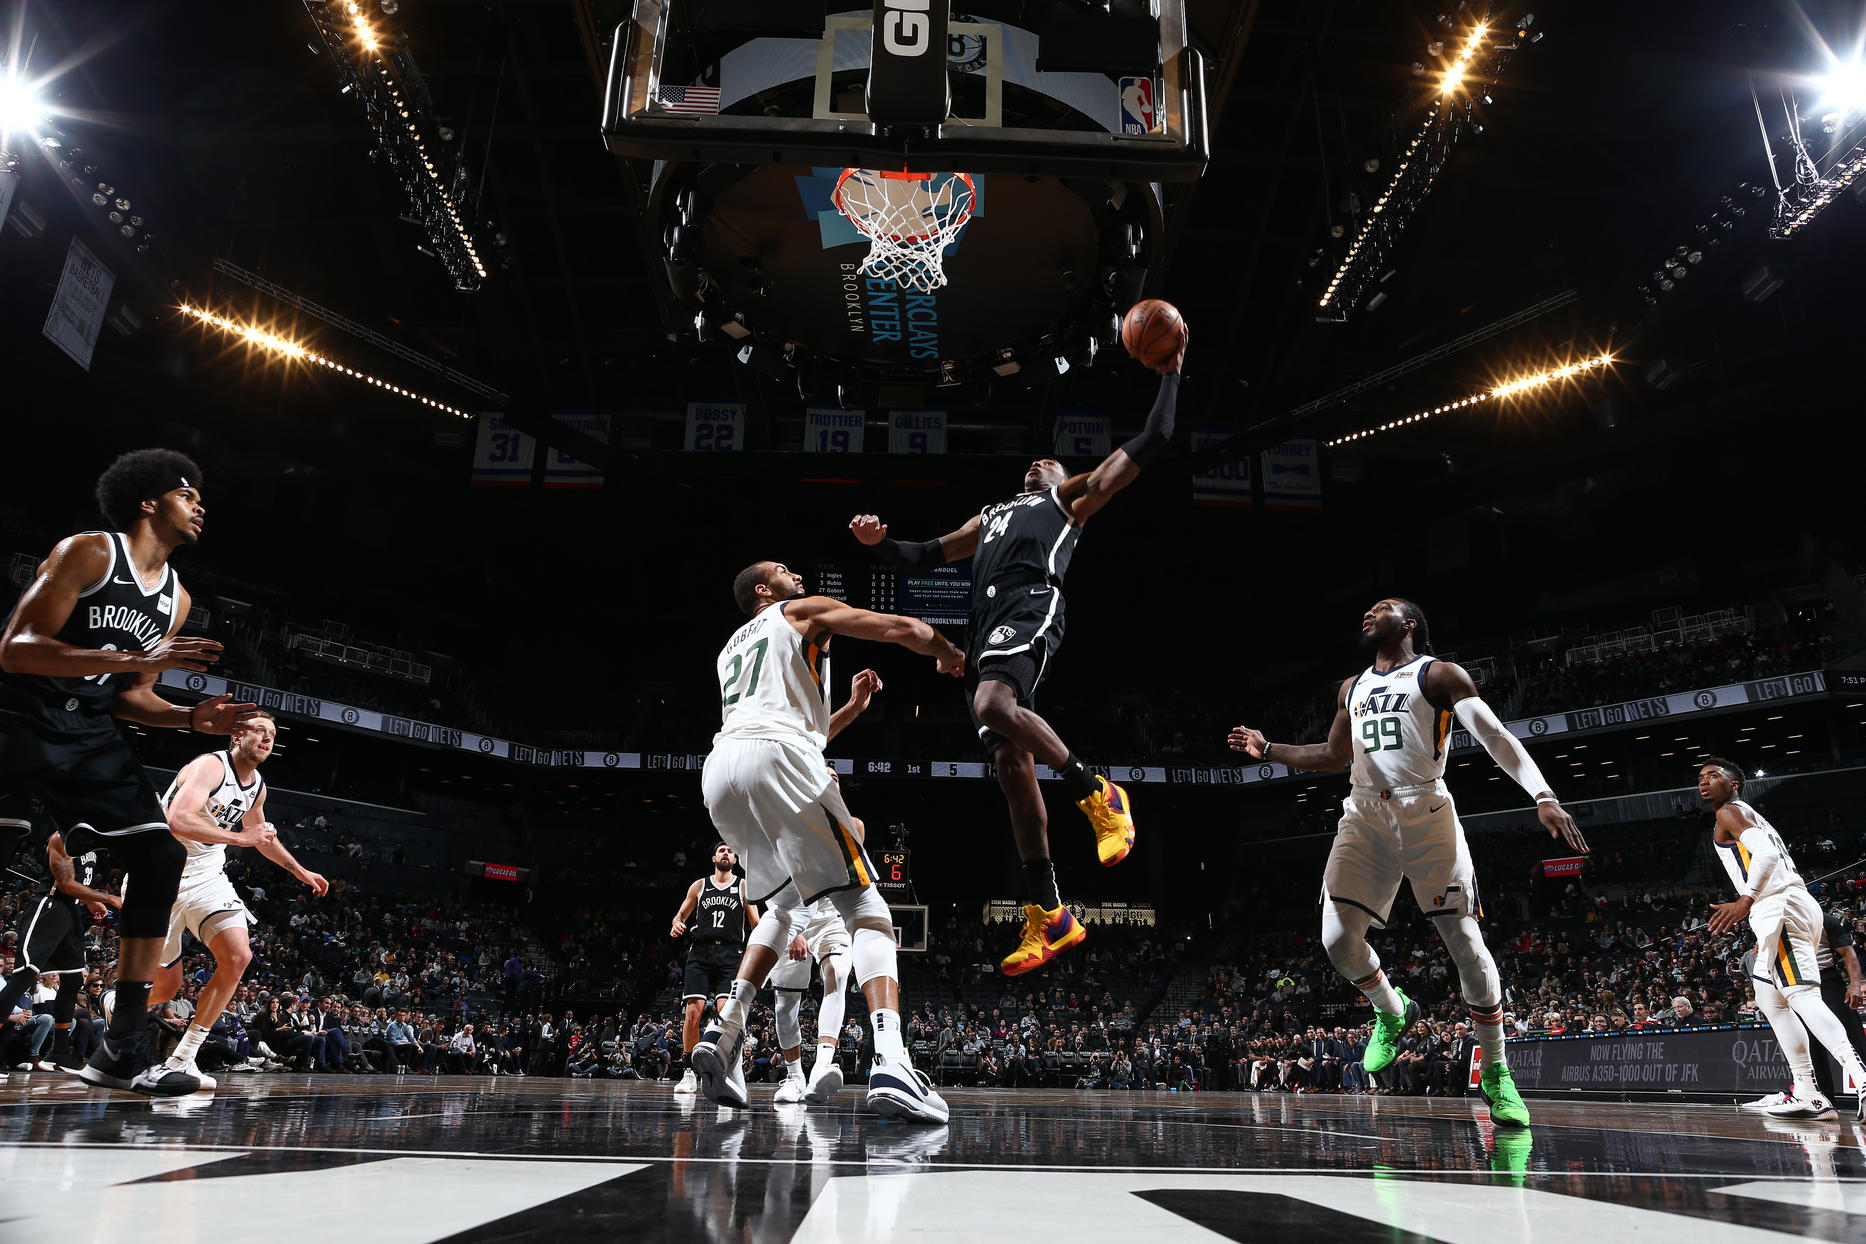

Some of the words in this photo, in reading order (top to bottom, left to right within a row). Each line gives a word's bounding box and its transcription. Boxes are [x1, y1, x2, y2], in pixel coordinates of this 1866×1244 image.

[1125, 123, 1142, 134] NBA
[840, 263, 865, 333] BROOKLYN
[695, 408, 738, 422] BOSSY
[808, 413, 863, 428] TROTTIER
[895, 416, 942, 430] GILLIES
[694, 424, 735, 451] 22
[1060, 421, 1105, 435] POTVIN
[488, 433, 520, 462] 31
[819, 430, 851, 453] 19
[908, 432, 928, 454] 9
[1073, 437, 1093, 456] 5
[981, 495, 1046, 527] BROOKLYN
[984, 511, 1014, 544] 24
[88, 605, 164, 652] BROOKLYN
[723, 637, 769, 708] 27
[1841, 676, 1859, 684] 7:51
[1754, 680, 1786, 701] LET'S
[1794, 676, 1813, 694] GO
[234, 683, 259, 704] LET'S
[266, 693, 279, 708] GO
[286, 694, 319, 716] NETS
[1575, 711, 1600, 730] LET'S
[1607, 708, 1623, 724] GO
[1628, 699, 1668, 721] NETS
[388, 717, 410, 735] LET'S
[415, 725, 428, 740] GO
[432, 726, 460, 746] NETS
[1362, 717, 1404, 754] 99
[1455, 733, 1468, 748] GO
[514, 745, 533, 761] LET'S
[537, 750, 550, 765] GO
[554, 751, 583, 766] NETS
[647, 754, 667, 769] LET'S
[672, 755, 684, 769] GO
[868, 761, 891, 773] 6:42
[907, 764, 921, 774] 1st
[949, 763, 958, 776] 5
[1172, 768, 1191, 783] LET'S
[1197, 769, 1209, 783] GO
[1213, 768, 1241, 784] NETS
[884, 854, 905, 864] 6:42
[1554, 864, 1574, 872] LUCAS
[891, 864, 902, 880] 6
[701, 896, 739, 910] BROOKLYN
[712, 910, 725, 928] 12
[1507, 1049, 1543, 1069] QATAR
[1590, 1044, 1611, 1061] NOW
[1612, 1043, 1643, 1061] FLYING
[1647, 1042, 1664, 1060] THE
[1732, 1039, 1785, 1068] QATA
[1561, 1065, 1590, 1082] AIRBUS
[1592, 1064, 1640, 1082] A350-1000
[1641, 1064, 1663, 1082] OUT
[1665, 1064, 1679, 1082] OF
[1681, 1063, 1699, 1082] JFK
[1747, 1065, 1793, 1080] AIRWAY
